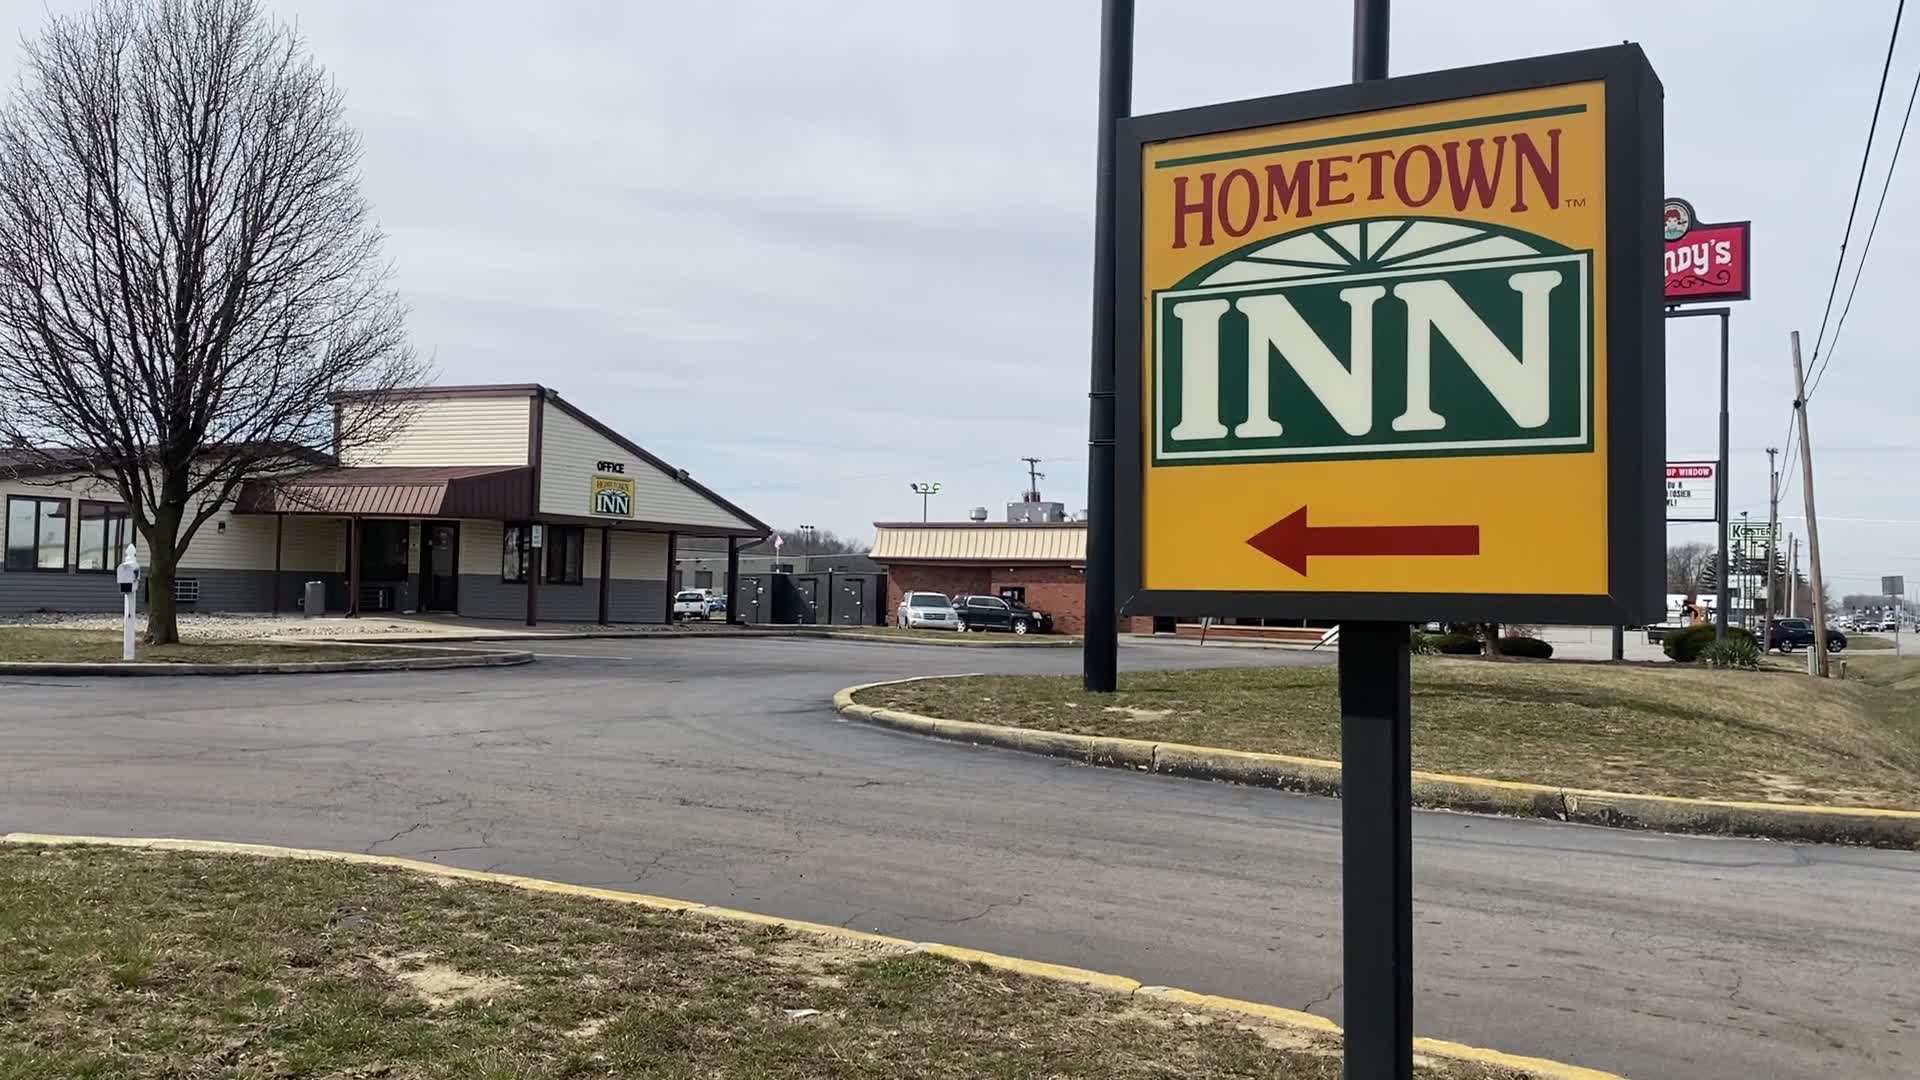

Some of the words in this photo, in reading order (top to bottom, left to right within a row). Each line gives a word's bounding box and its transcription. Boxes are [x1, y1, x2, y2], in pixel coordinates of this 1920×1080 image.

[1171, 128, 1563, 249] HOMETOWN
[1170, 269, 1564, 441] INN
[597, 460, 625, 474] OFFICE
[1678, 467, 1710, 476] WINDOW
[1667, 481, 1675, 489] OU
[597, 495, 629, 513] INN
